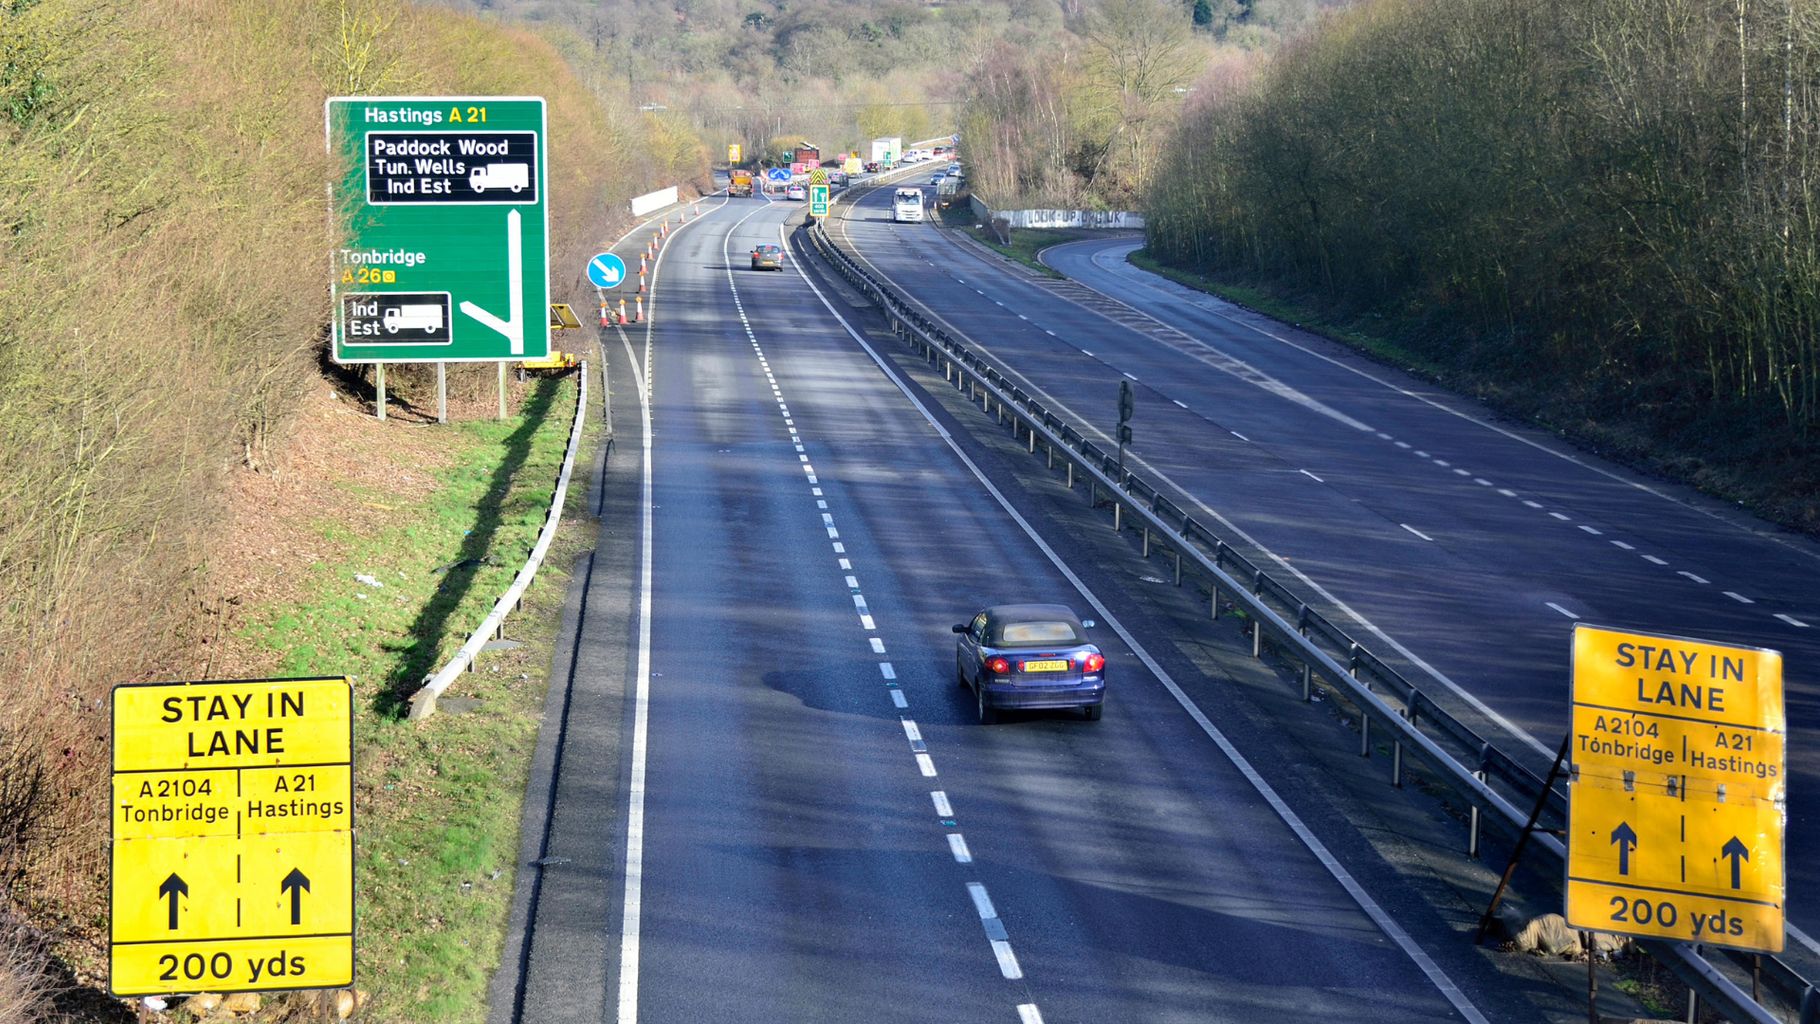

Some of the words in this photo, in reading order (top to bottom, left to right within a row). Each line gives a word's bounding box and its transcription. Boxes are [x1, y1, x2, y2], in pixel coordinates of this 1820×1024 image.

[365, 107, 443, 126] Hastings
[449, 107, 462, 123] A
[467, 107, 487, 123] 21
[374, 140, 450, 156] Paddock
[458, 140, 508, 155] Wood
[375, 159, 412, 175] Tun.
[415, 159, 465, 175] Wells
[388, 179, 415, 194] Ind
[421, 179, 451, 194] Est
[341, 249, 426, 267] Tonbridge
[341, 269, 353, 283] A
[358, 269, 381, 283] 26
[352, 302, 378, 316] Ind
[351, 322, 381, 335] Est
[1615, 642, 1698, 675] STAY
[1710, 654, 1744, 682] IN
[1637, 678, 1725, 712] LANE
[161, 693, 254, 723] STAY
[267, 691, 305, 718] IN
[188, 728, 285, 757] LANE
[1578, 735, 1675, 765] Tonbridge
[1690, 750, 1777, 779] Hastings
[122, 802, 229, 823] Tonbridge
[247, 798, 344, 818] Hastings
[1609, 896, 1678, 928] 200
[1690, 909, 1744, 936] yds
[158, 952, 233, 980] 200
[247, 950, 306, 983] yds
